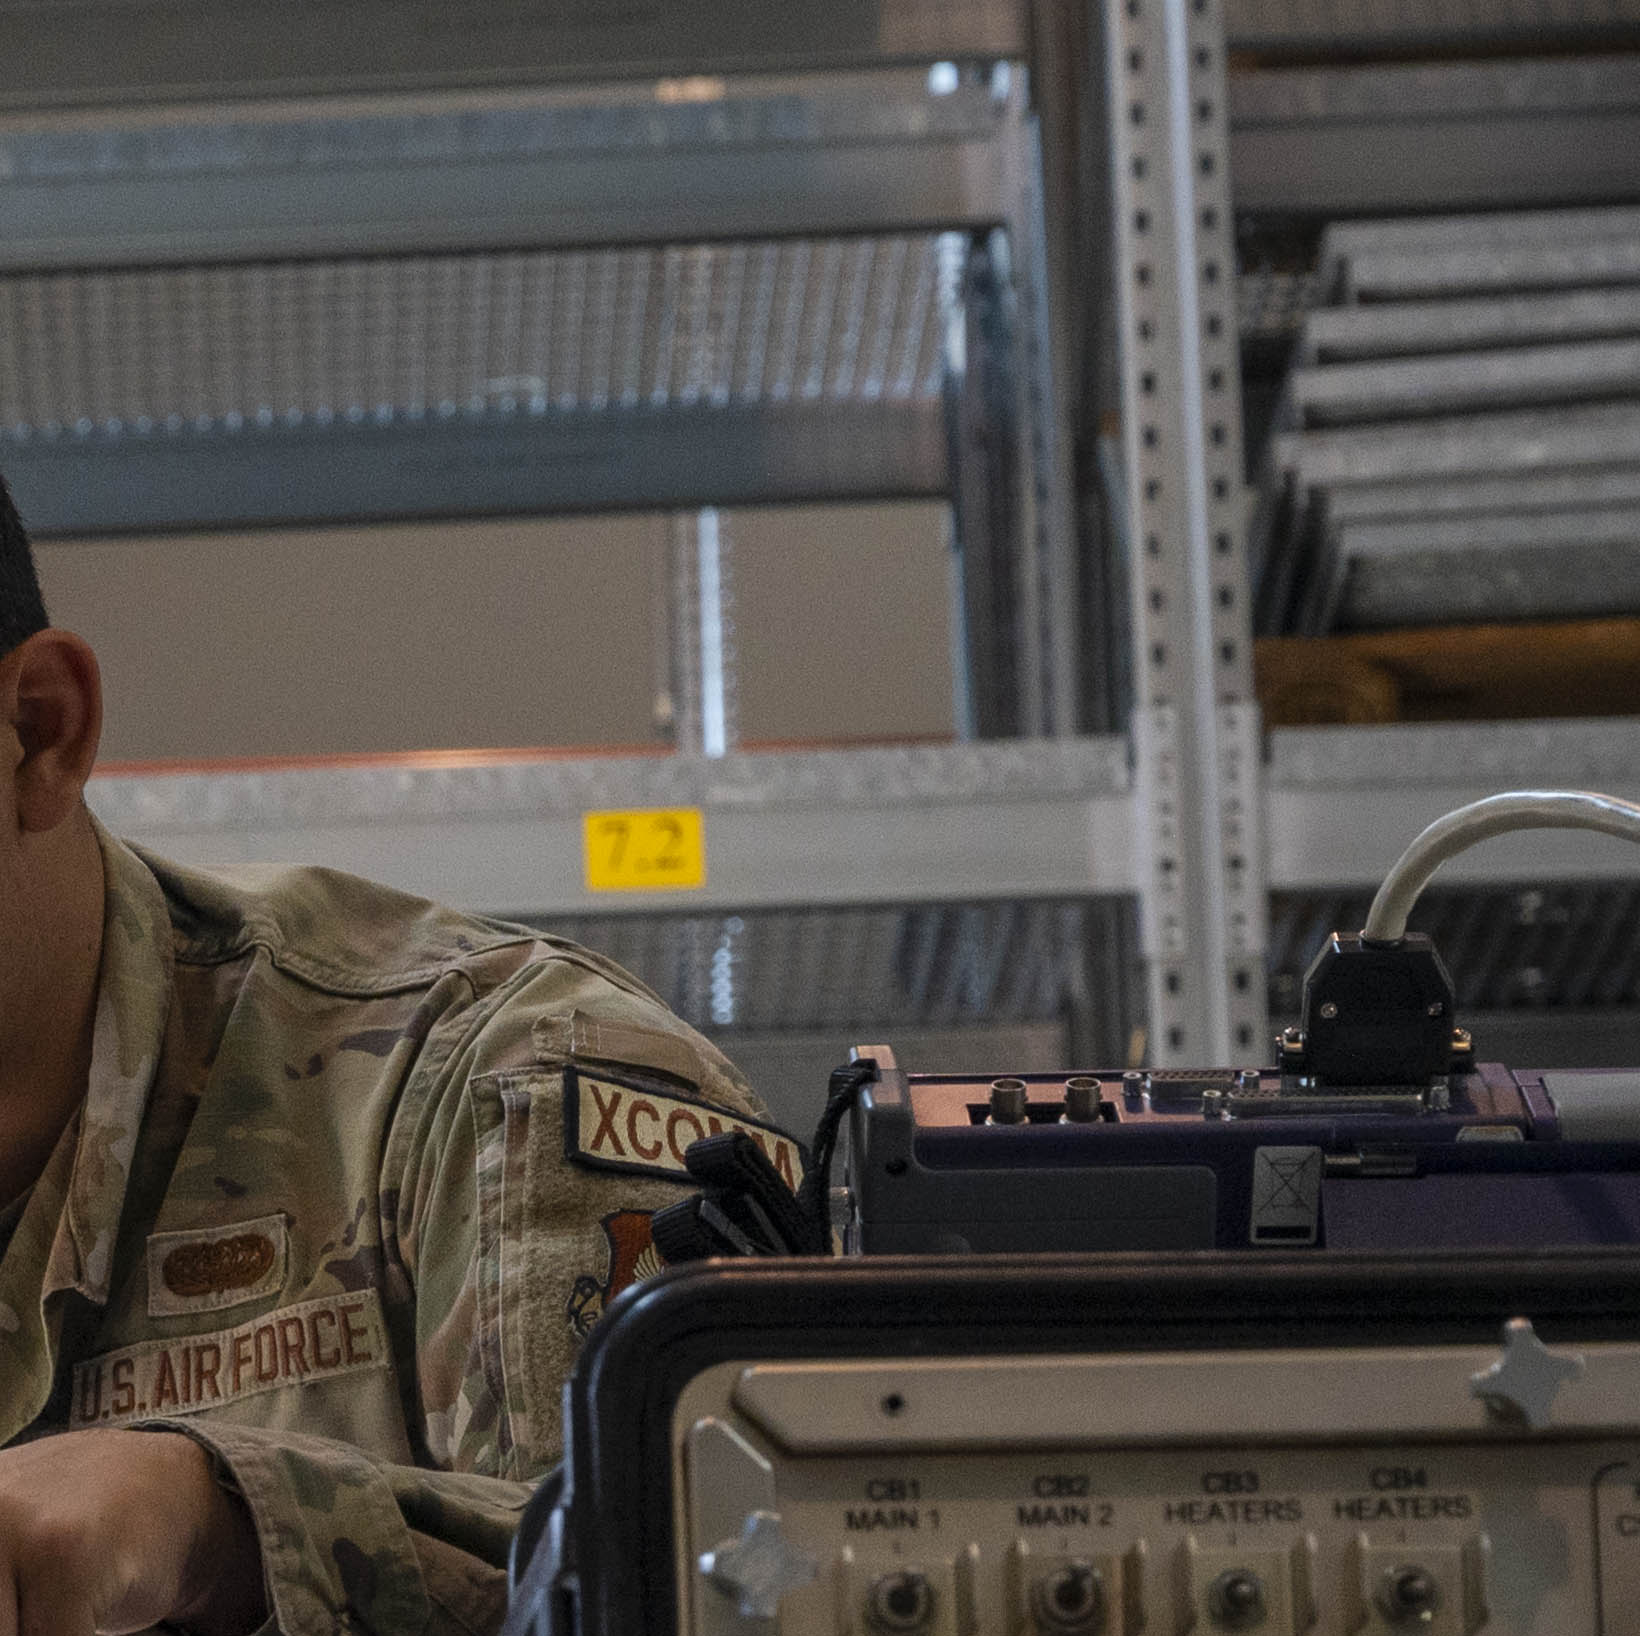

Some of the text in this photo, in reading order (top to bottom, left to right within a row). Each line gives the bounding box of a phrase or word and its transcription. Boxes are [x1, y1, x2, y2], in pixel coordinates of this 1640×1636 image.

[76, 1302, 372, 1422] U.S. AIR FORCE
[867, 1478, 920, 1500] CB1
[1033, 1475, 1089, 1497] CB2
[1202, 1472, 1258, 1494] CB3
[1369, 1468, 1426, 1489] CB4
[1018, 1504, 1113, 1527] MAIN 2
[1166, 1500, 1301, 1523] HEATERS
[1335, 1496, 1472, 1519] HEATERS
[845, 1510, 940, 1530] MAIN 1
